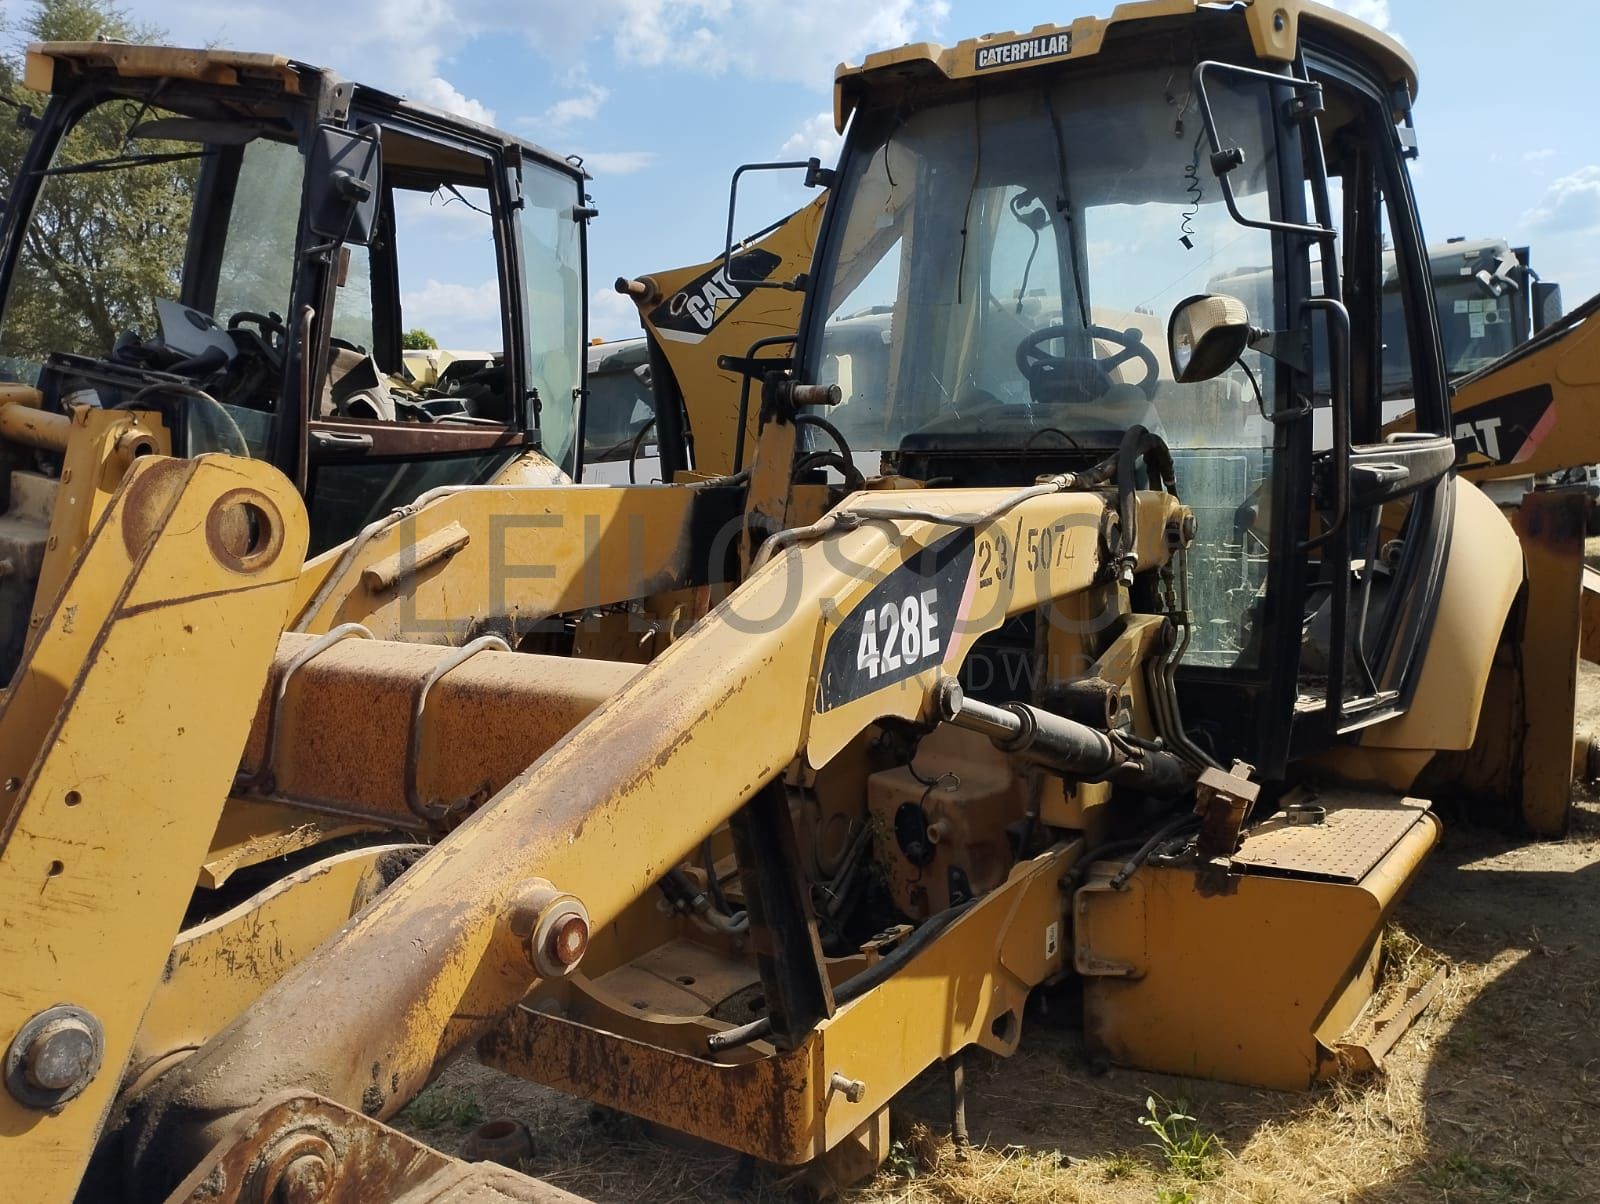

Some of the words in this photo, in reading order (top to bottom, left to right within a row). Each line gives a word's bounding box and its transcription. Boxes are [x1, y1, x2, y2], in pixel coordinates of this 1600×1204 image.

[979, 34, 1068, 67] CATERPILLAR
[686, 266, 742, 329] CAT
[1454, 417, 1502, 461] AT
[857, 588, 940, 679] 428E
